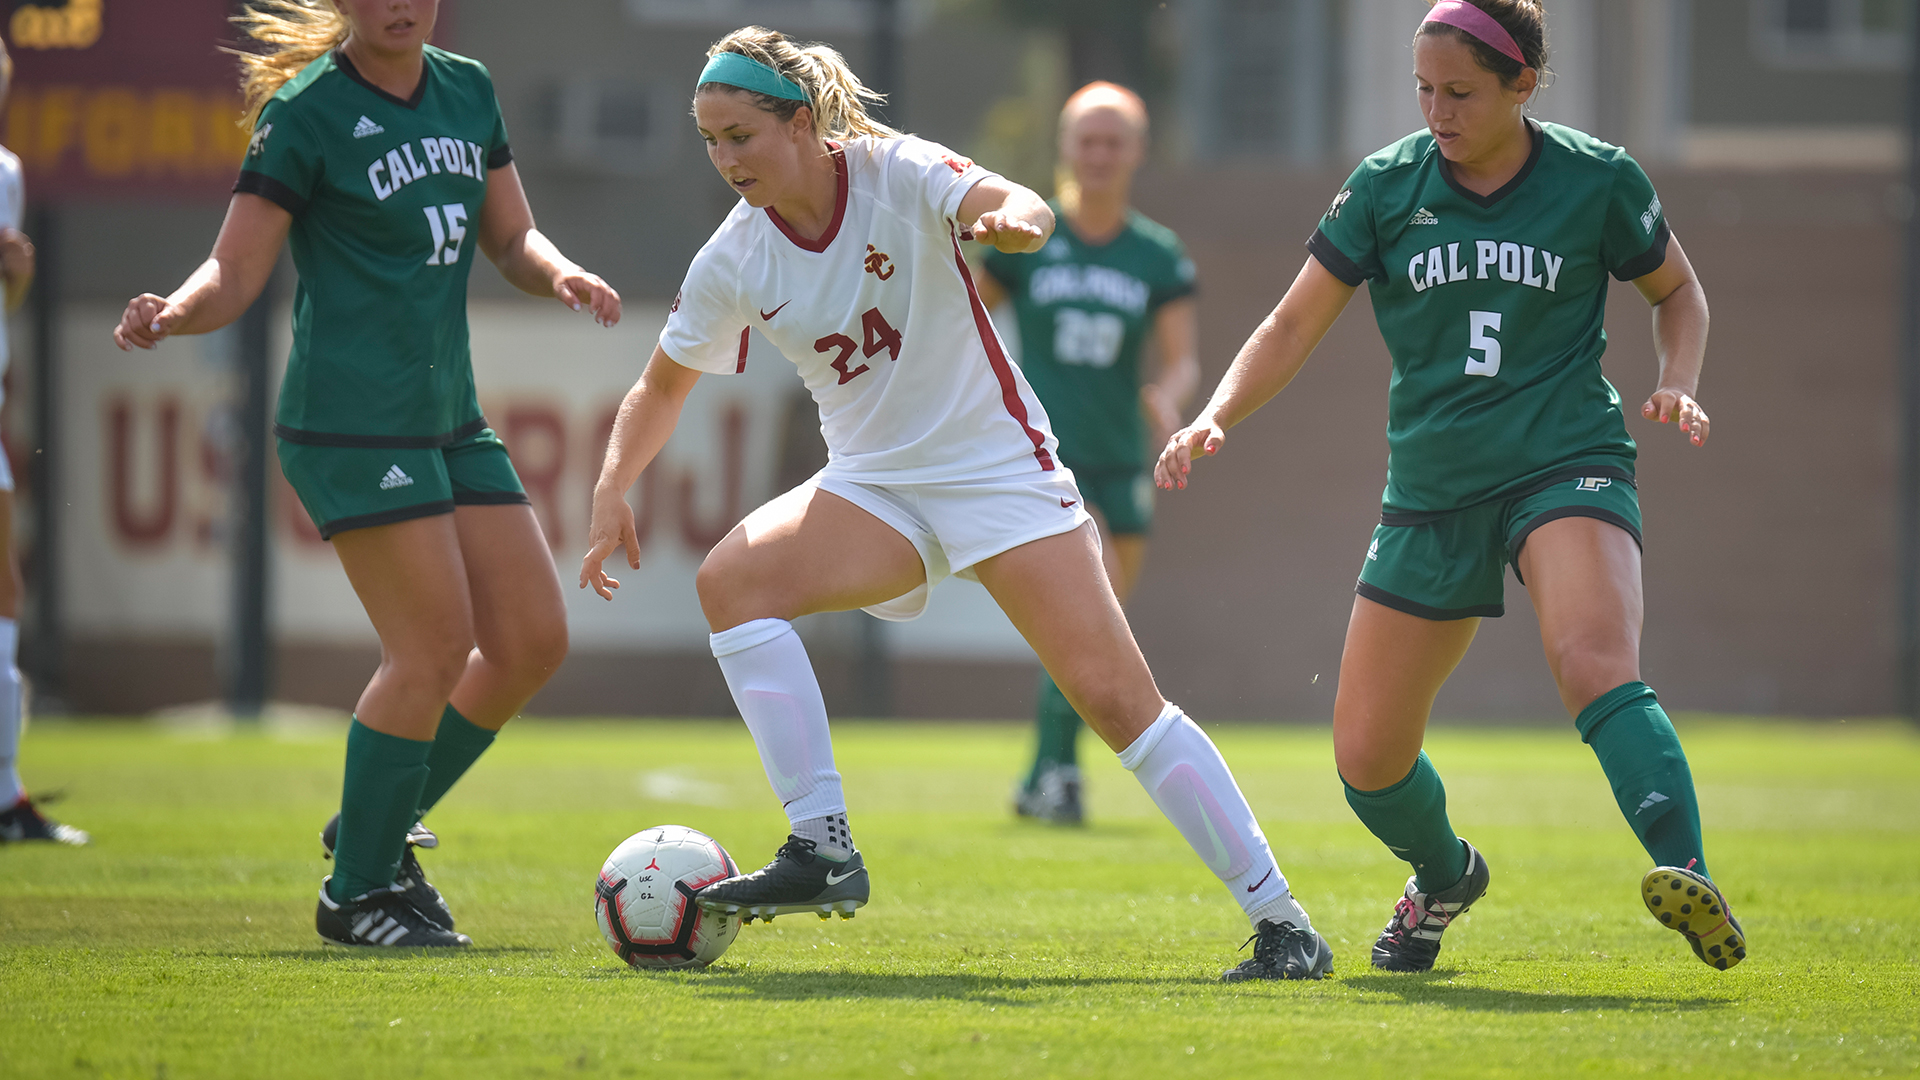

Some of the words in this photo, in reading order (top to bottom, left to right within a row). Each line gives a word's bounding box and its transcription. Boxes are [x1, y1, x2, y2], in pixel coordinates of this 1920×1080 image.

[367, 142, 428, 201] CAL
[420, 136, 484, 182] POLY
[422, 203, 468, 265] 15
[1408, 242, 1468, 293] CAL
[1475, 240, 1564, 293] POLY
[813, 307, 903, 385] 24
[1464, 310, 1502, 377] 5
[639, 875, 654, 883] USC
